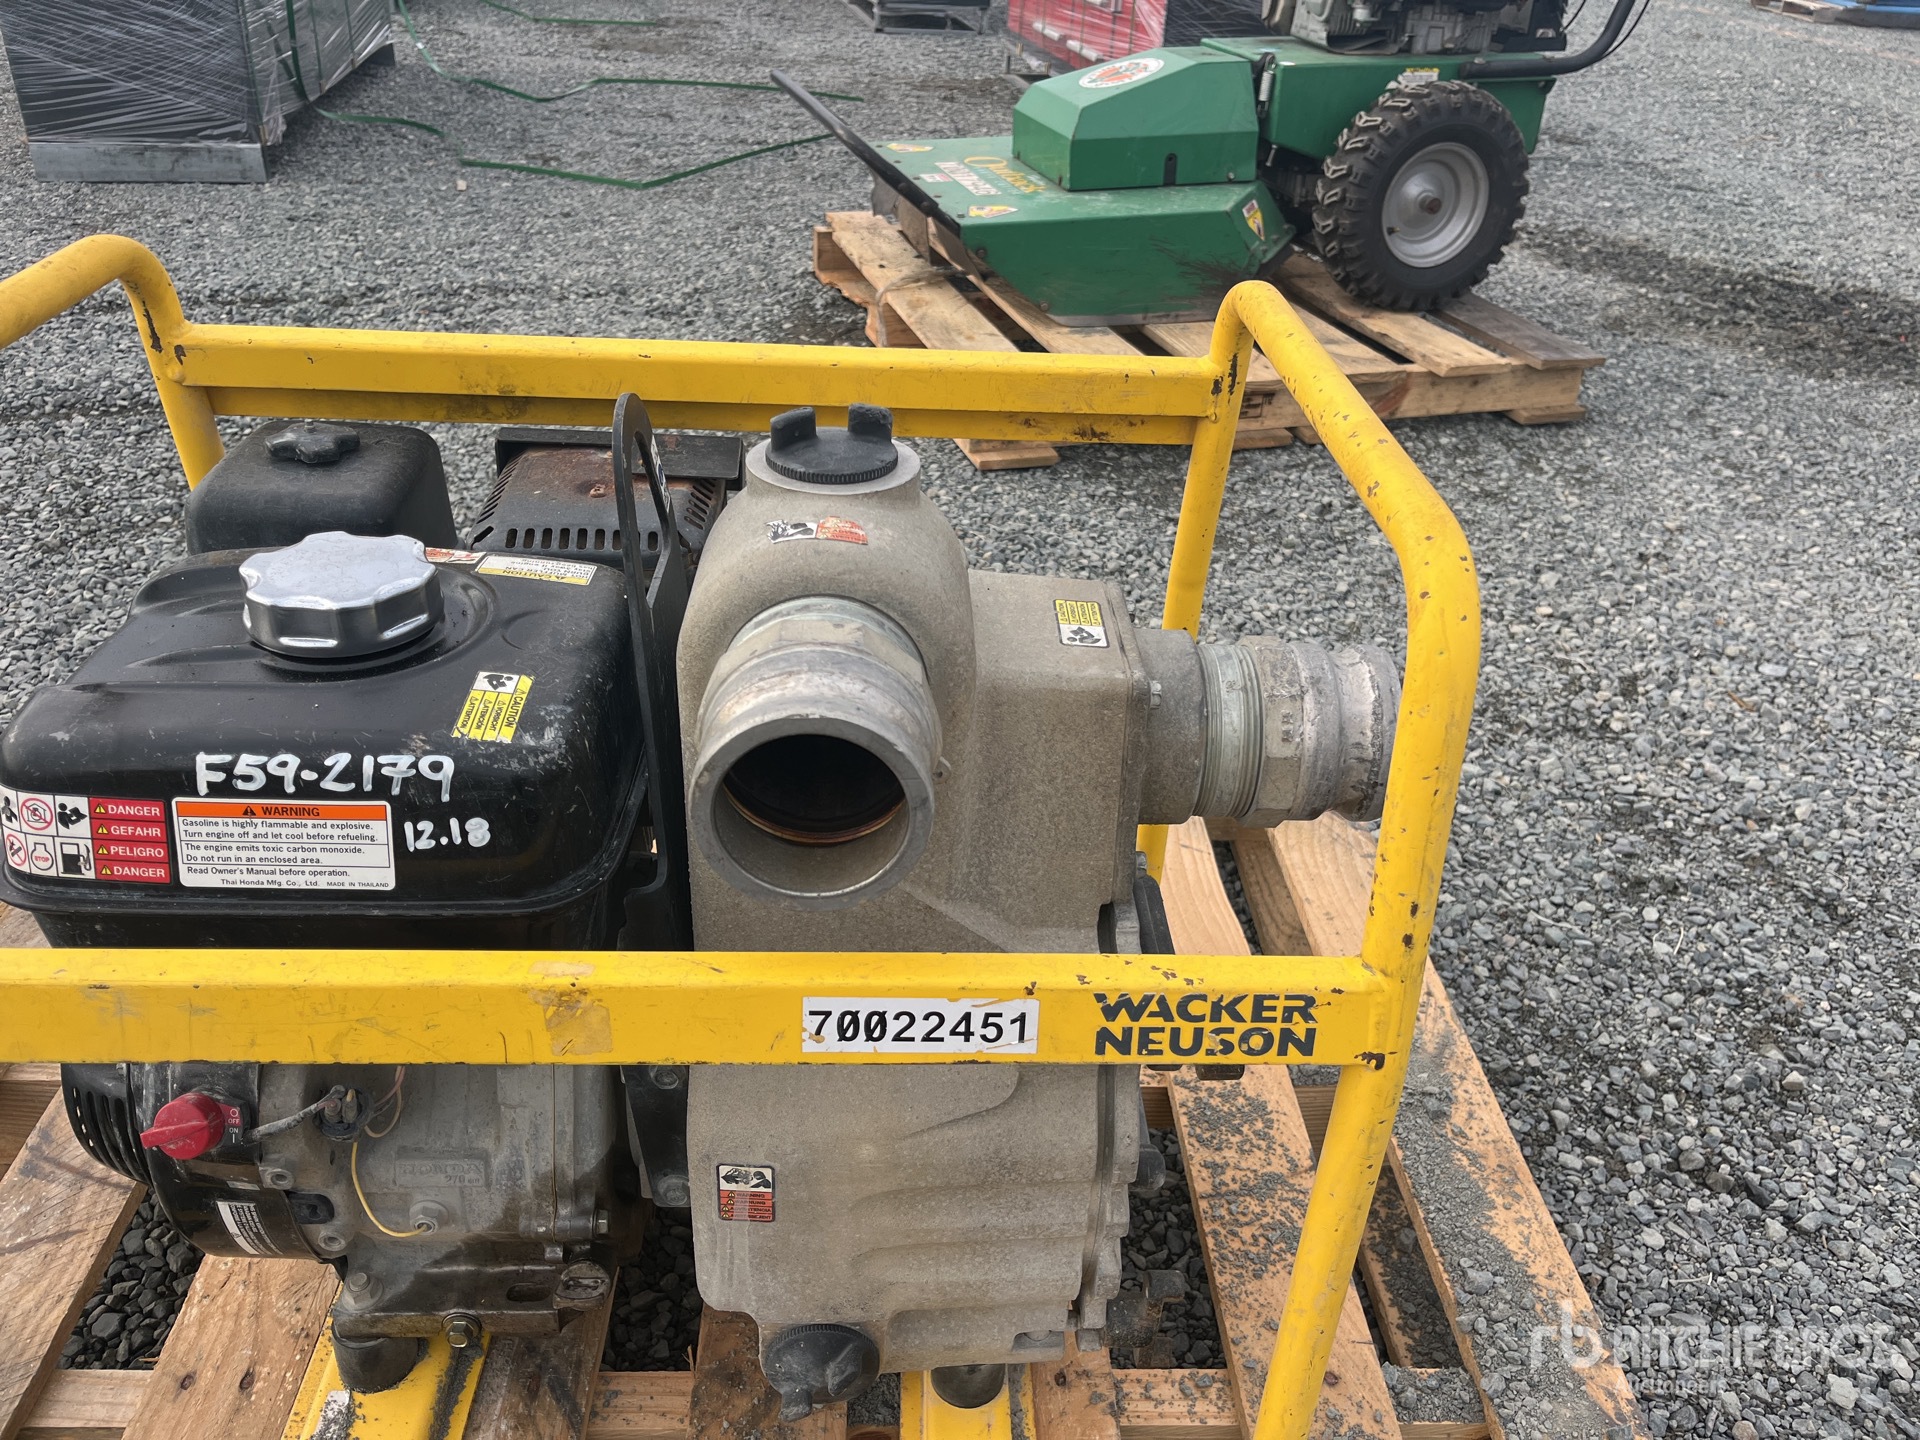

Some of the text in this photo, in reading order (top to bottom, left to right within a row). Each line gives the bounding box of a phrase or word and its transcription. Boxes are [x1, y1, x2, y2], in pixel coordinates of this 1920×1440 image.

[502, 570, 551, 578] CAUTION
[504, 696, 524, 729] CAUTION
[195, 751, 455, 802] F59-2179
[108, 805, 160, 816] DANGER
[261, 806, 320, 817] WARNING
[182, 818, 219, 827] Gasoline
[222, 819, 230, 827] is
[232, 820, 258, 829] highly
[261, 820, 308, 829] flammable
[330, 822, 373, 831] explosive.
[110, 826, 161, 837] GEFAHR
[183, 830, 203, 838] Turn
[206, 831, 235, 840] engine
[285, 832, 304, 840] cool
[306, 832, 334, 840] before
[337, 833, 378, 842] refueling.
[403, 817, 491, 852] 12.18
[110, 846, 164, 858] PELIGRO
[204, 844, 233, 852] engine
[236, 844, 260, 852] emits
[262, 844, 284, 852] toxic
[320, 846, 365, 854] monoxide.
[186, 854, 198, 862] Do
[258, 856, 298, 864] enclosed
[114, 866, 165, 878] DANGER
[187, 866, 208, 874] Read
[246, 868, 276, 876] Manual
[278, 868, 306, 876] before
[308, 869, 350, 877] operation.
[1093, 992, 1319, 1024] WACKER
[808, 1010, 1027, 1044] 70022451
[1095, 1026, 1317, 1057] NEUSON
